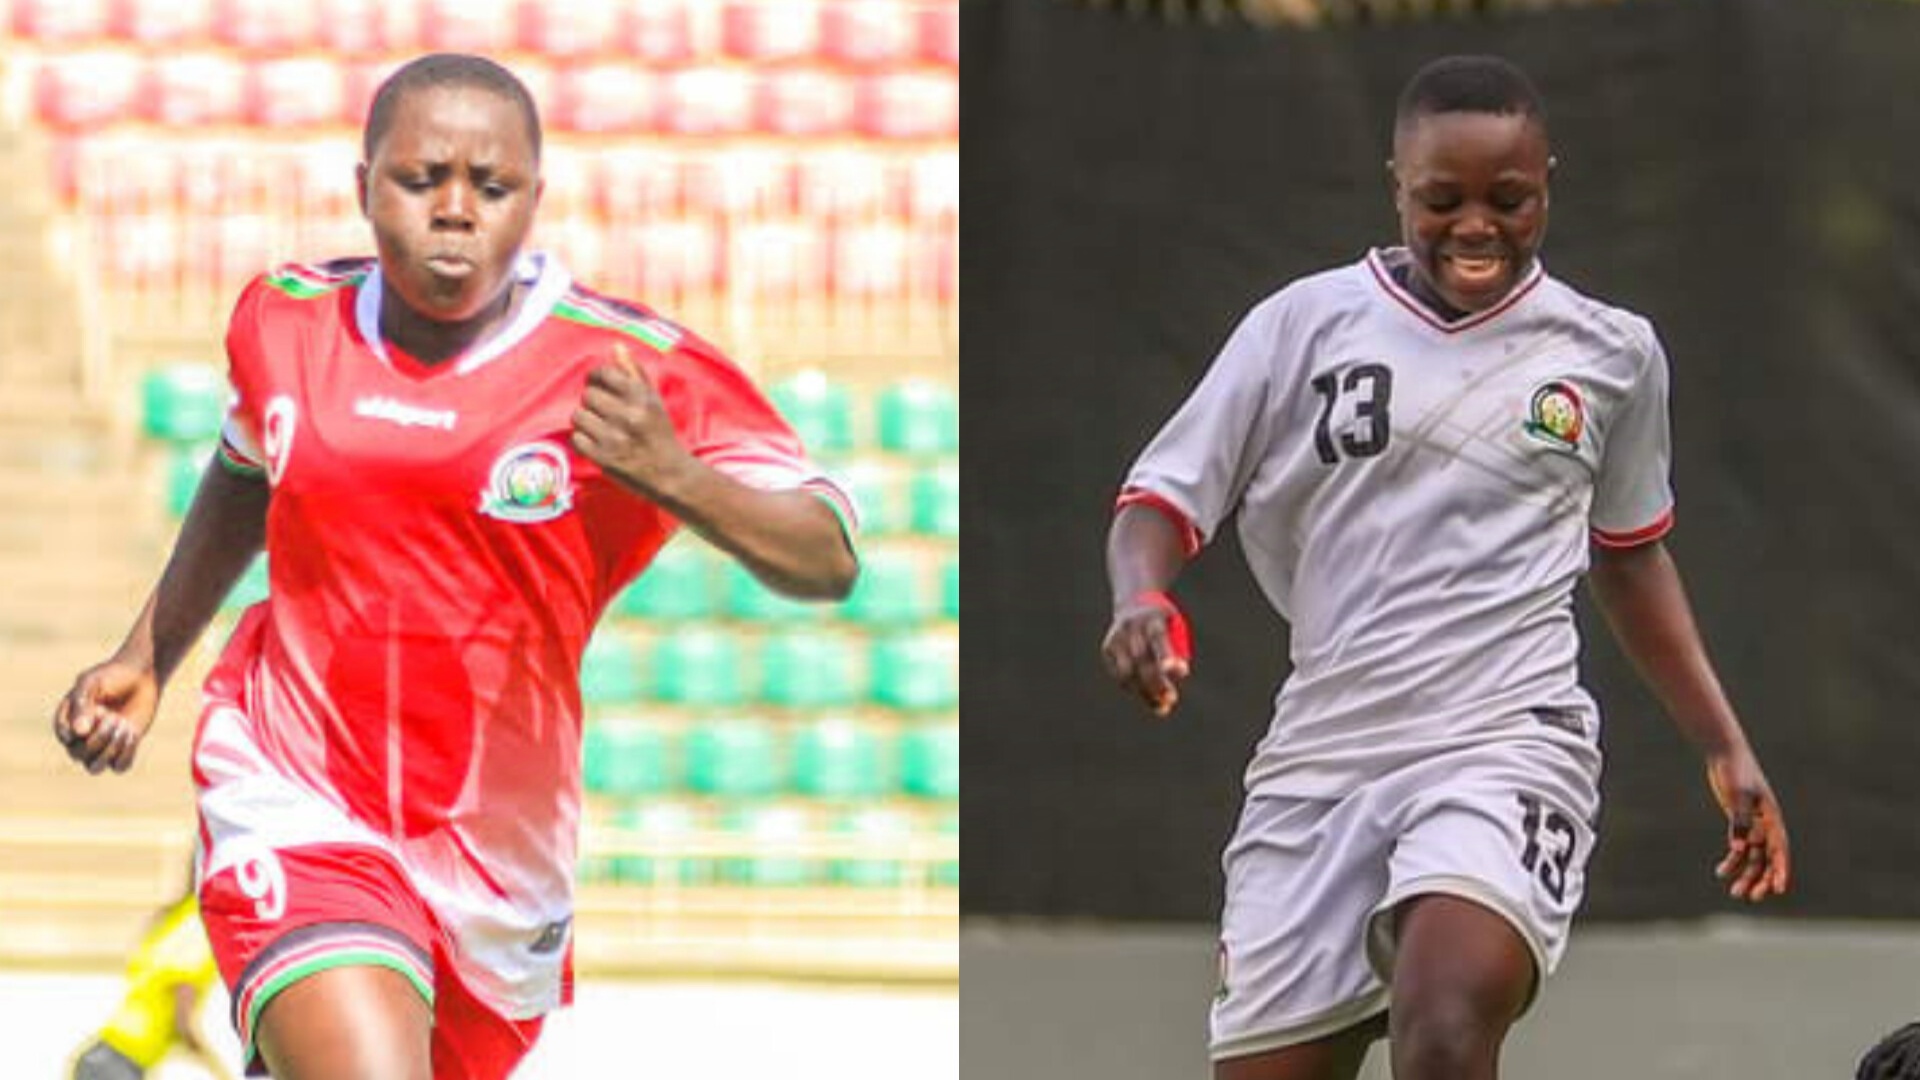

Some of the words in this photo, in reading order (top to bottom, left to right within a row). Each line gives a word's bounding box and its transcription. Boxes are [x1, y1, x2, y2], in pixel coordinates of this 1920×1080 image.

[264, 395, 296, 487] 9
[1311, 363, 1392, 464] 13
[237, 848, 286, 920] 9
[1518, 792, 1575, 904] 13
